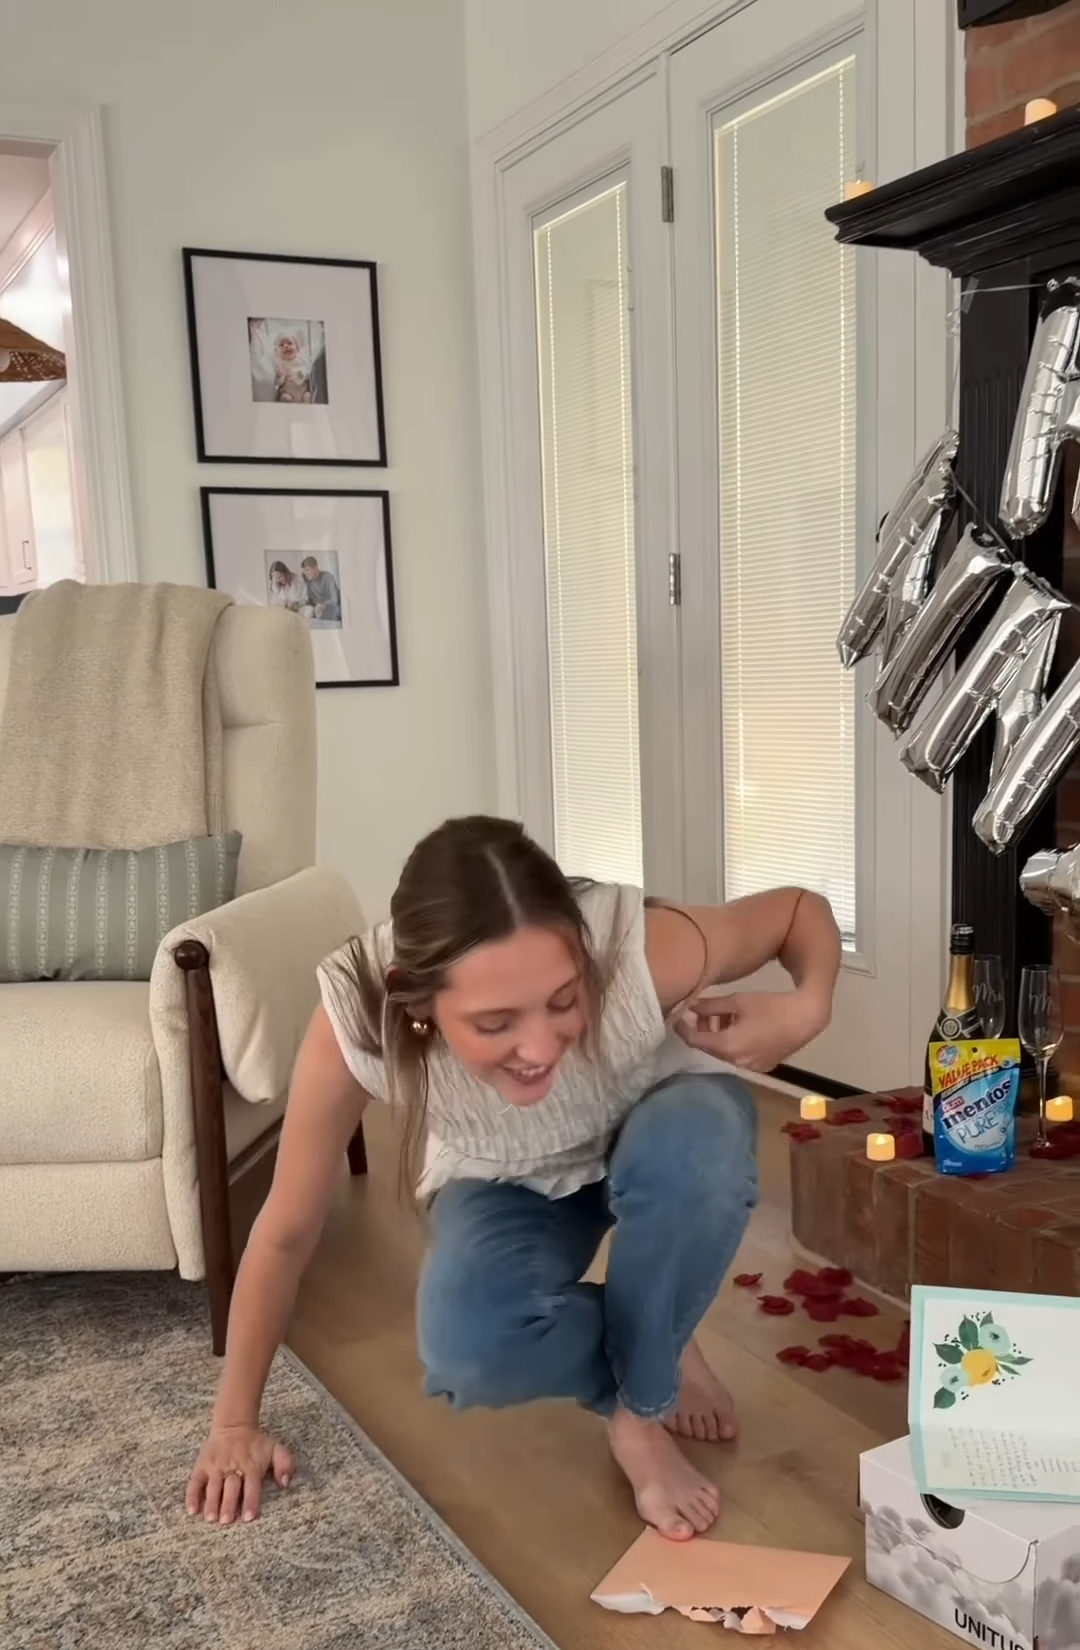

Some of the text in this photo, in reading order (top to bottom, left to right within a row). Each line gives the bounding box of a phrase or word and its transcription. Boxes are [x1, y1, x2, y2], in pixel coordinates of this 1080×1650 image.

[938, 1062, 971, 1088] VALUE
[971, 1055, 998, 1072] PACK
[942, 1080, 1011, 1129] mentos
[956, 1110, 999, 1144] PURE
